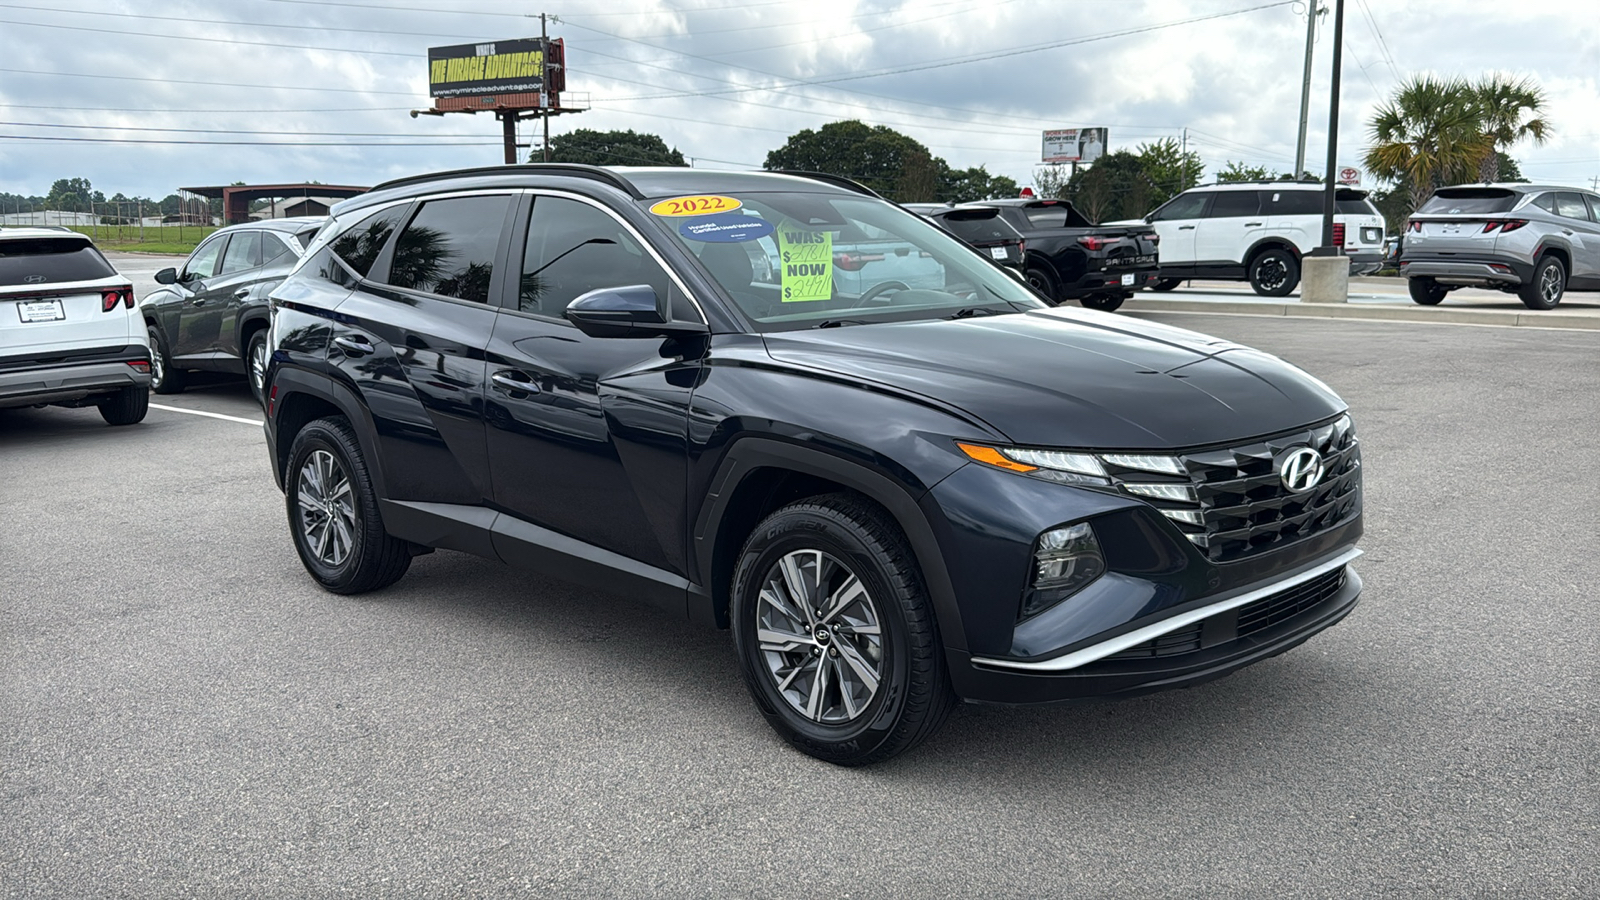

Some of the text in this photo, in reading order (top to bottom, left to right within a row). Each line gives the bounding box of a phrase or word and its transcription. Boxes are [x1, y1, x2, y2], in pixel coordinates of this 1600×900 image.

[475, 43, 496, 56] WHAT IS
[430, 60, 447, 84] THE
[446, 56, 486, 83] MIRACLE
[668, 197, 725, 214] 2022
[688, 222, 717, 231] Hyundai
[693, 226, 721, 234] Certified
[784, 231, 825, 244] WAS
[1105, 255, 1155, 266] SANTA CRUZ
[787, 263, 826, 277] NOW
[767, 520, 828, 540] CRUGEN
